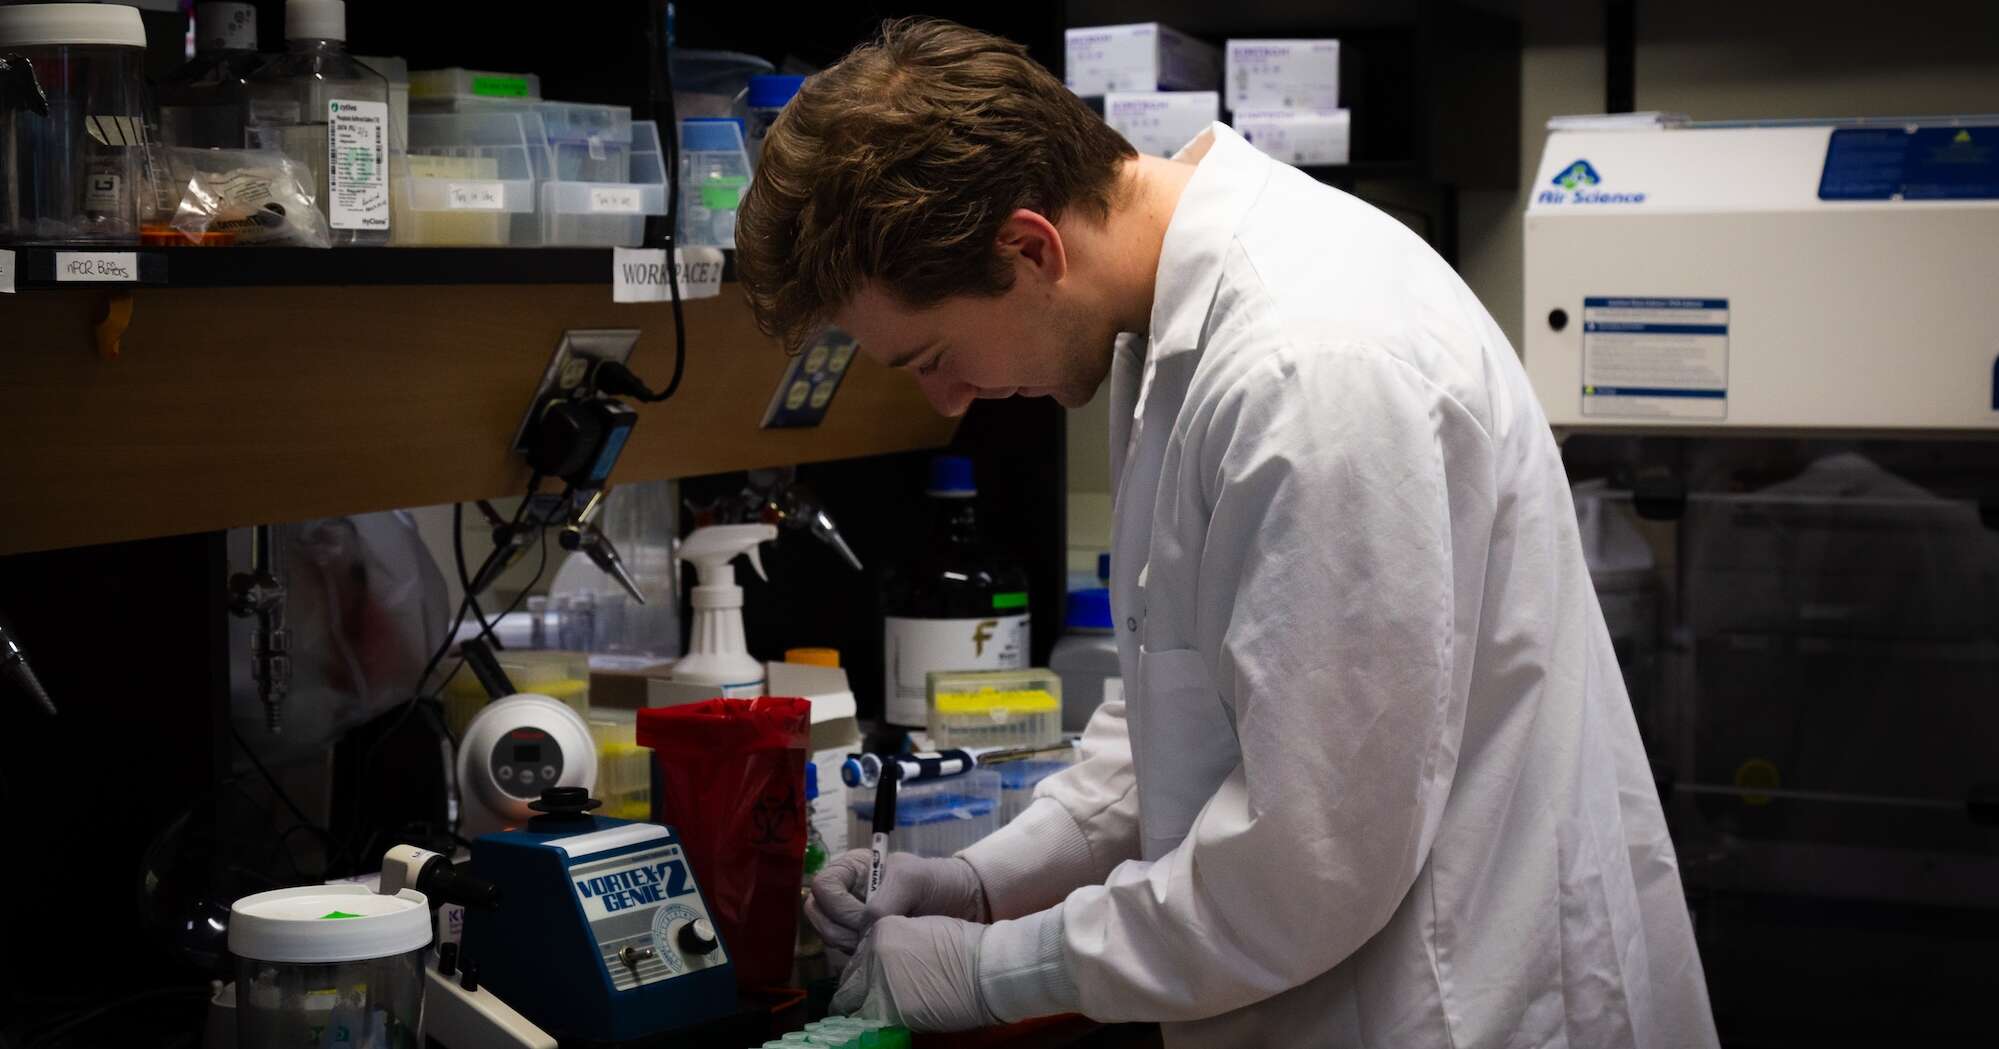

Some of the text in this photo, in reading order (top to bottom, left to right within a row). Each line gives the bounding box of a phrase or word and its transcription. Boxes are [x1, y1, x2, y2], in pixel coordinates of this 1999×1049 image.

[1538, 190, 1646, 204] Air Science
[623, 262, 710, 286] WORKPACE
[656, 859, 697, 898] 2
[601, 881, 668, 912] GENIE
